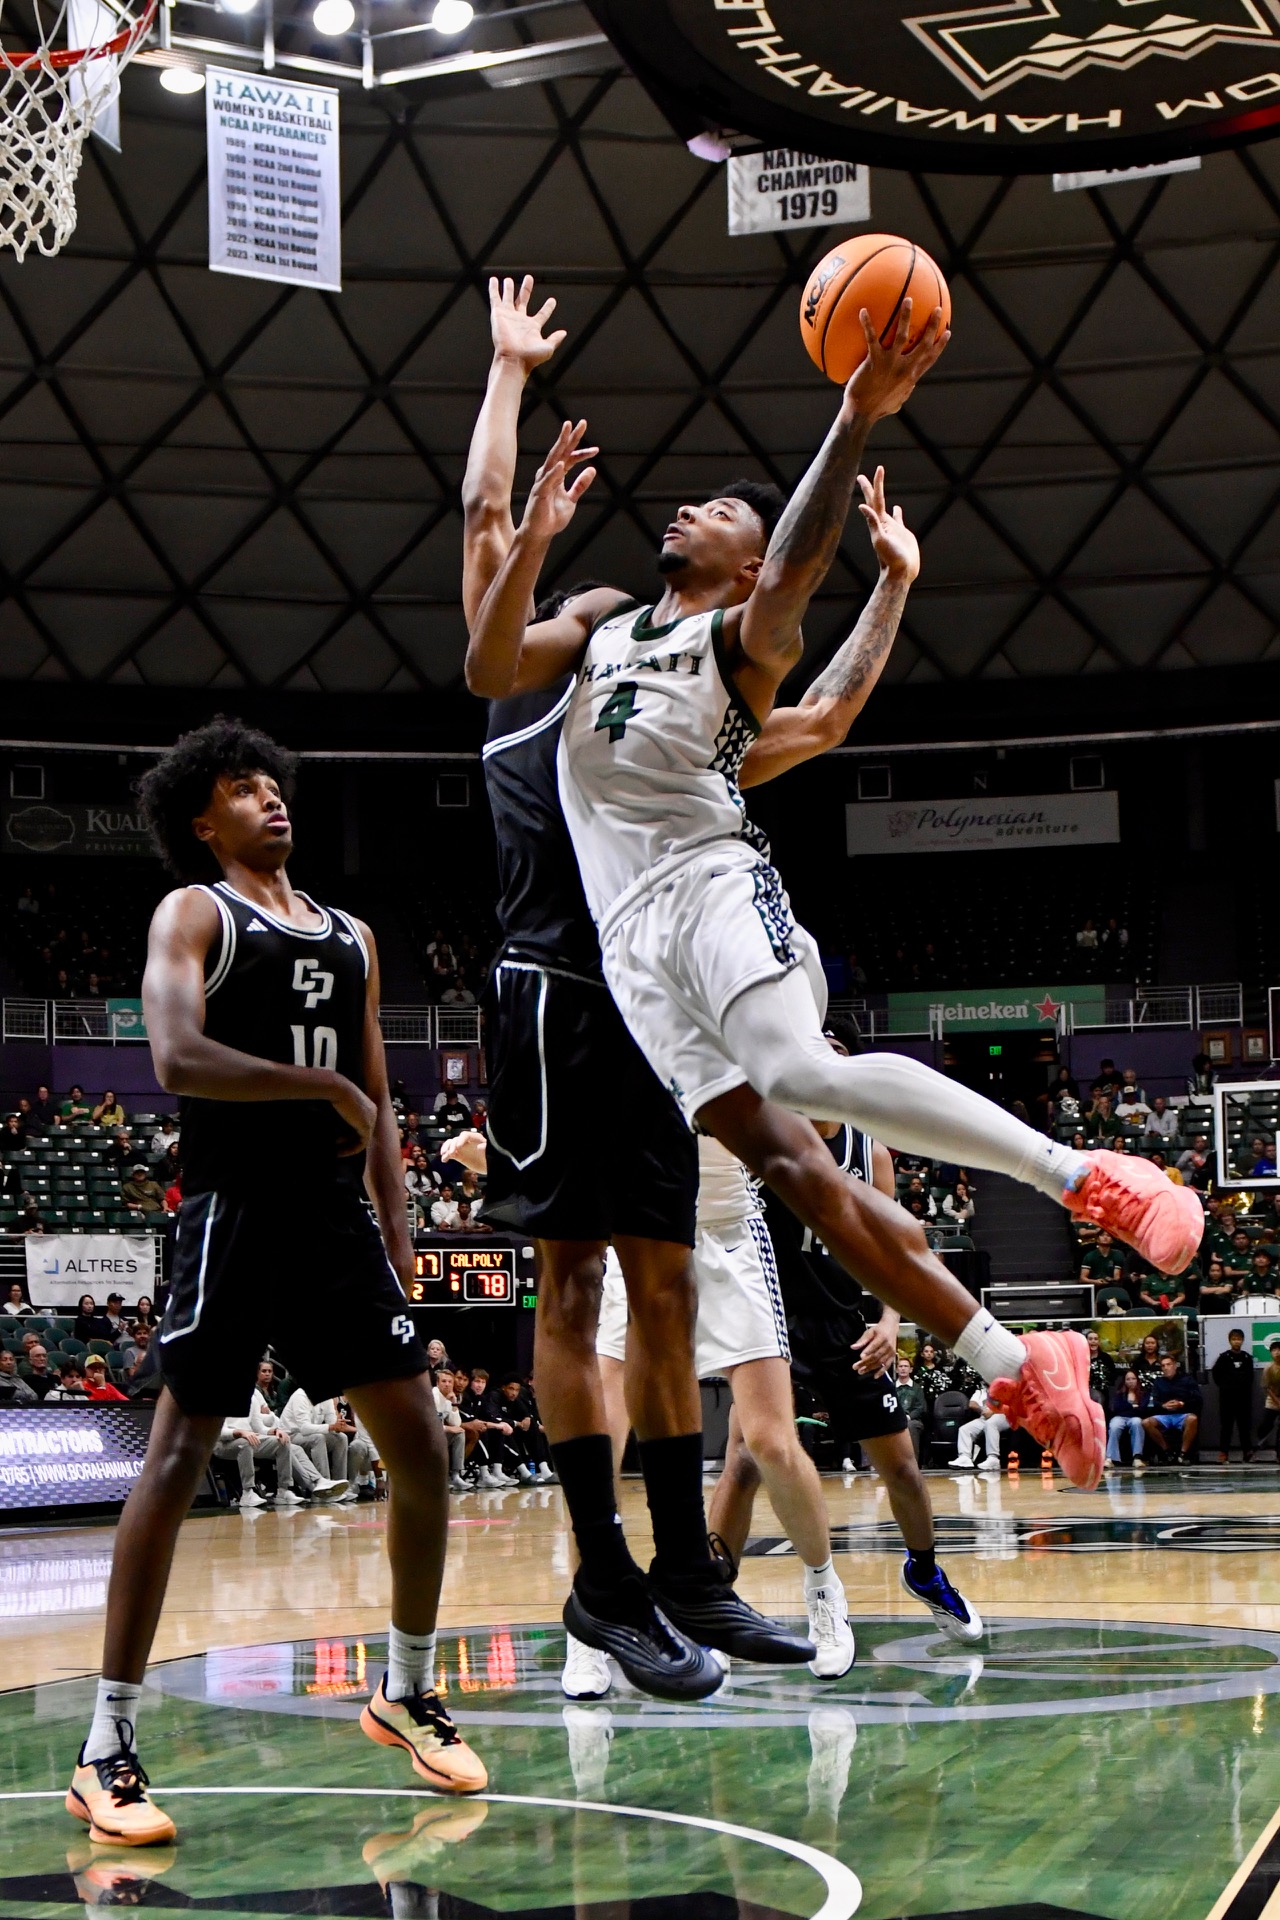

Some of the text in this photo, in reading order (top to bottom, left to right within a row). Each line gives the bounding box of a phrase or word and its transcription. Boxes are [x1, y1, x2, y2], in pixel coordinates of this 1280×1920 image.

[215, 79, 330, 115] HAWAII
[213, 98, 333, 131] WOMEN'S BASKETBALL
[220, 115, 327, 145] NCAA APPEARANCES
[254, 142, 276, 153] NCAA
[292, 149, 318, 161] Round
[253, 158, 275, 169] NCAA
[295, 165, 321, 177] Round
[253, 174, 275, 185] NCAA
[291, 180, 318, 192] Round
[758, 163, 857, 193] CHAMPION
[254, 190, 276, 200] NCAA
[292, 196, 318, 208] Round
[777, 189, 838, 221] 1979
[254, 206, 276, 217] NCAA
[292, 212, 318, 224] Round
[254, 221, 276, 232] NCAA
[292, 228, 318, 240] Round
[254, 237, 275, 248] NCAA
[291, 243, 316, 255] Round
[255, 253, 276, 264] NCAA
[292, 259, 318, 271] Round
[594, 681, 643, 743] 4
[996, 824, 1079, 836] adventure
[929, 1002, 1029, 1022] Heineken
[290, 1024, 338, 1072] 10
[65, 1259, 138, 1273] ALTRES
[412, 1283, 424, 1300] 2
[477, 1274, 505, 1297] 78
[0, 1430, 104, 1455] NTRACTORS
